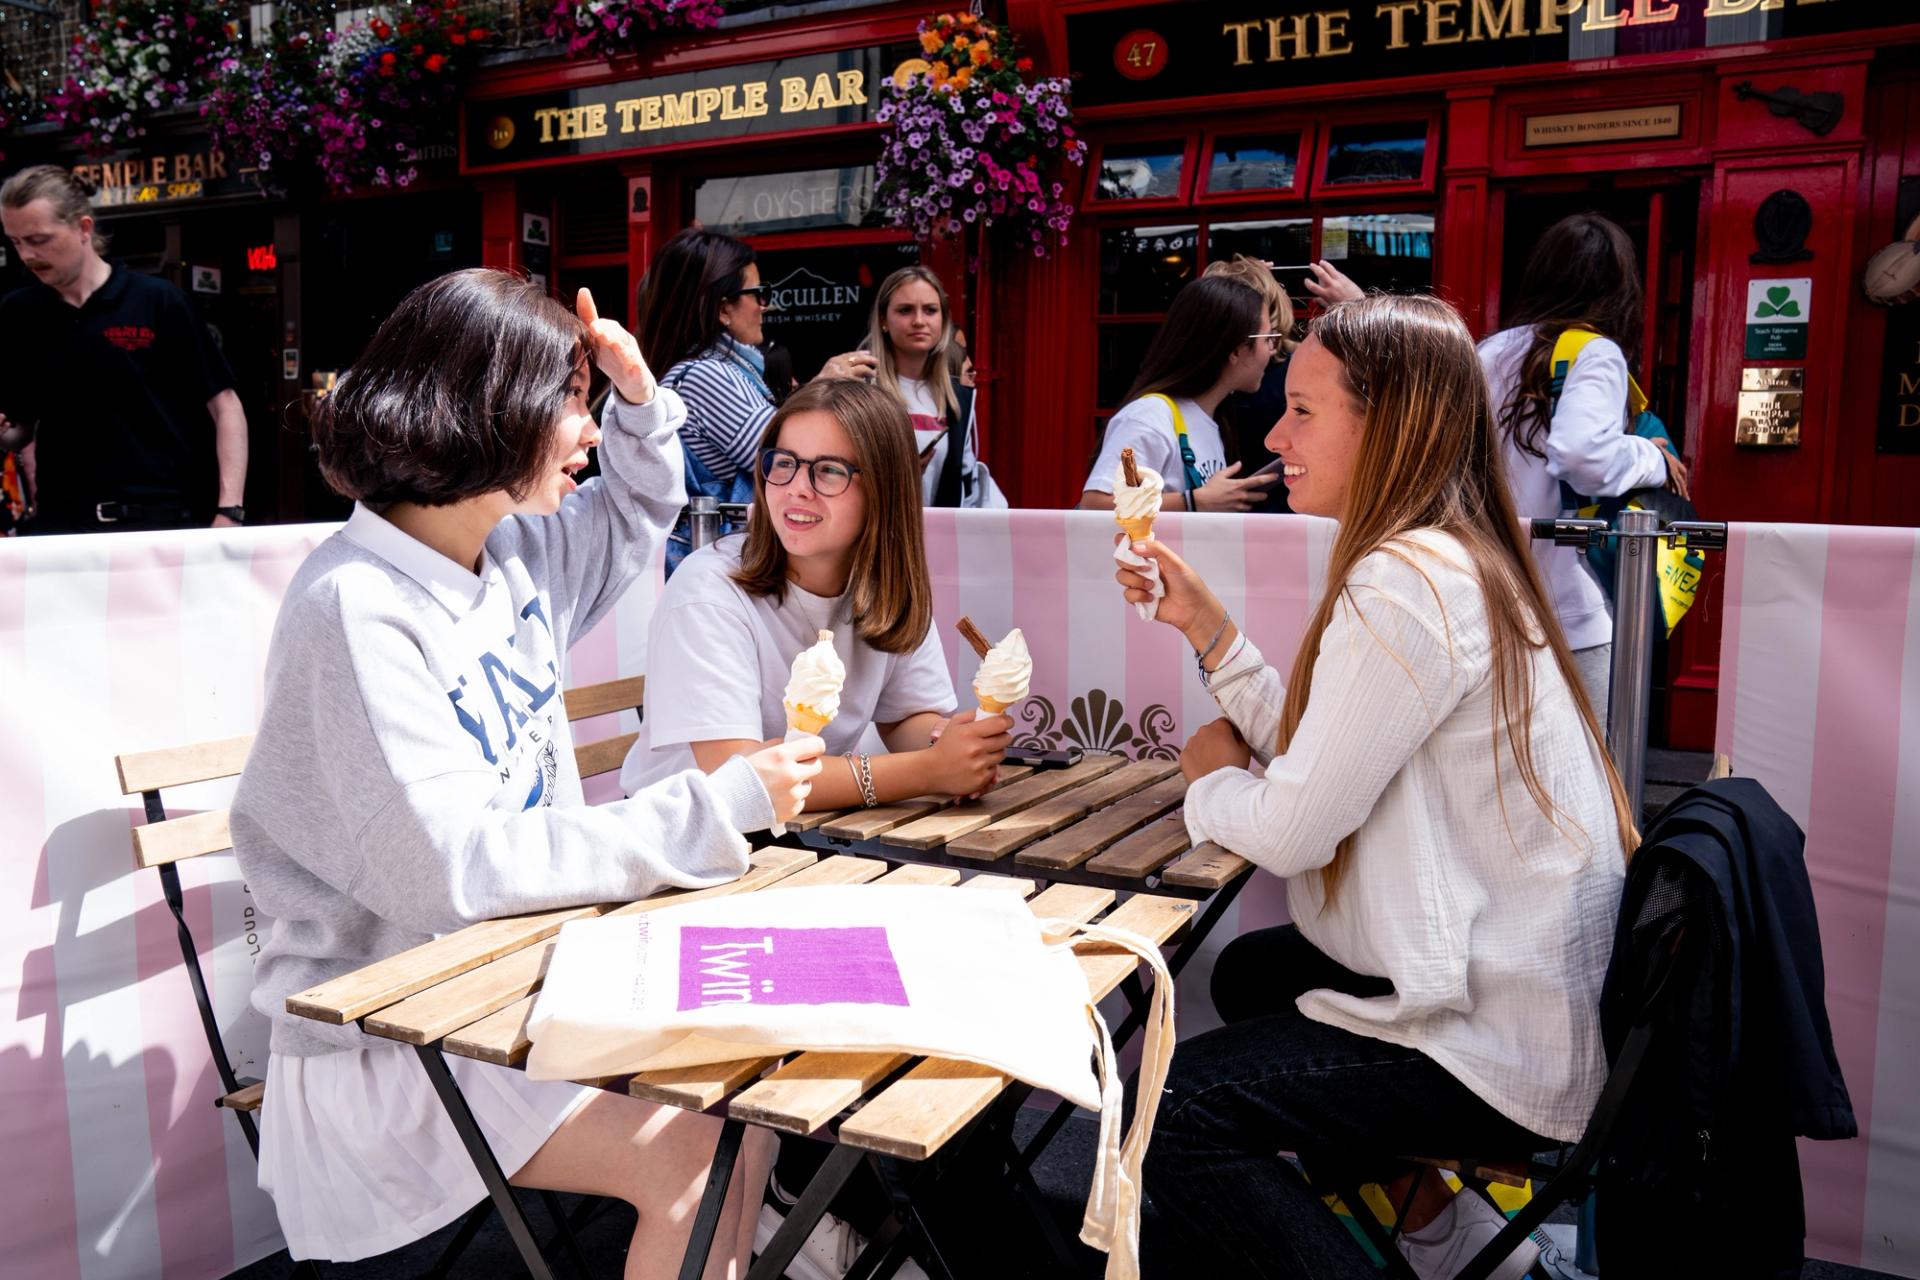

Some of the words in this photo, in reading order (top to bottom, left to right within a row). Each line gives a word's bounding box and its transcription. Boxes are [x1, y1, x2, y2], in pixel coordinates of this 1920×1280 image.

[1222, 9, 1354, 66] THE
[1127, 42, 1157, 67] 47
[534, 103, 608, 143] THE
[615, 81, 769, 133] TEMPLE
[780, 69, 869, 113] BAR
[1533, 125, 1575, 135] WHISKEY
[1622, 118, 1650, 128] SINCE
[174, 150, 228, 184] BAR
[753, 183, 875, 221] OYSTERS
[769, 286, 861, 312] RCULLEN
[794, 312, 842, 323] WHISKEY
[1749, 410, 1790, 418] TEMPLE
